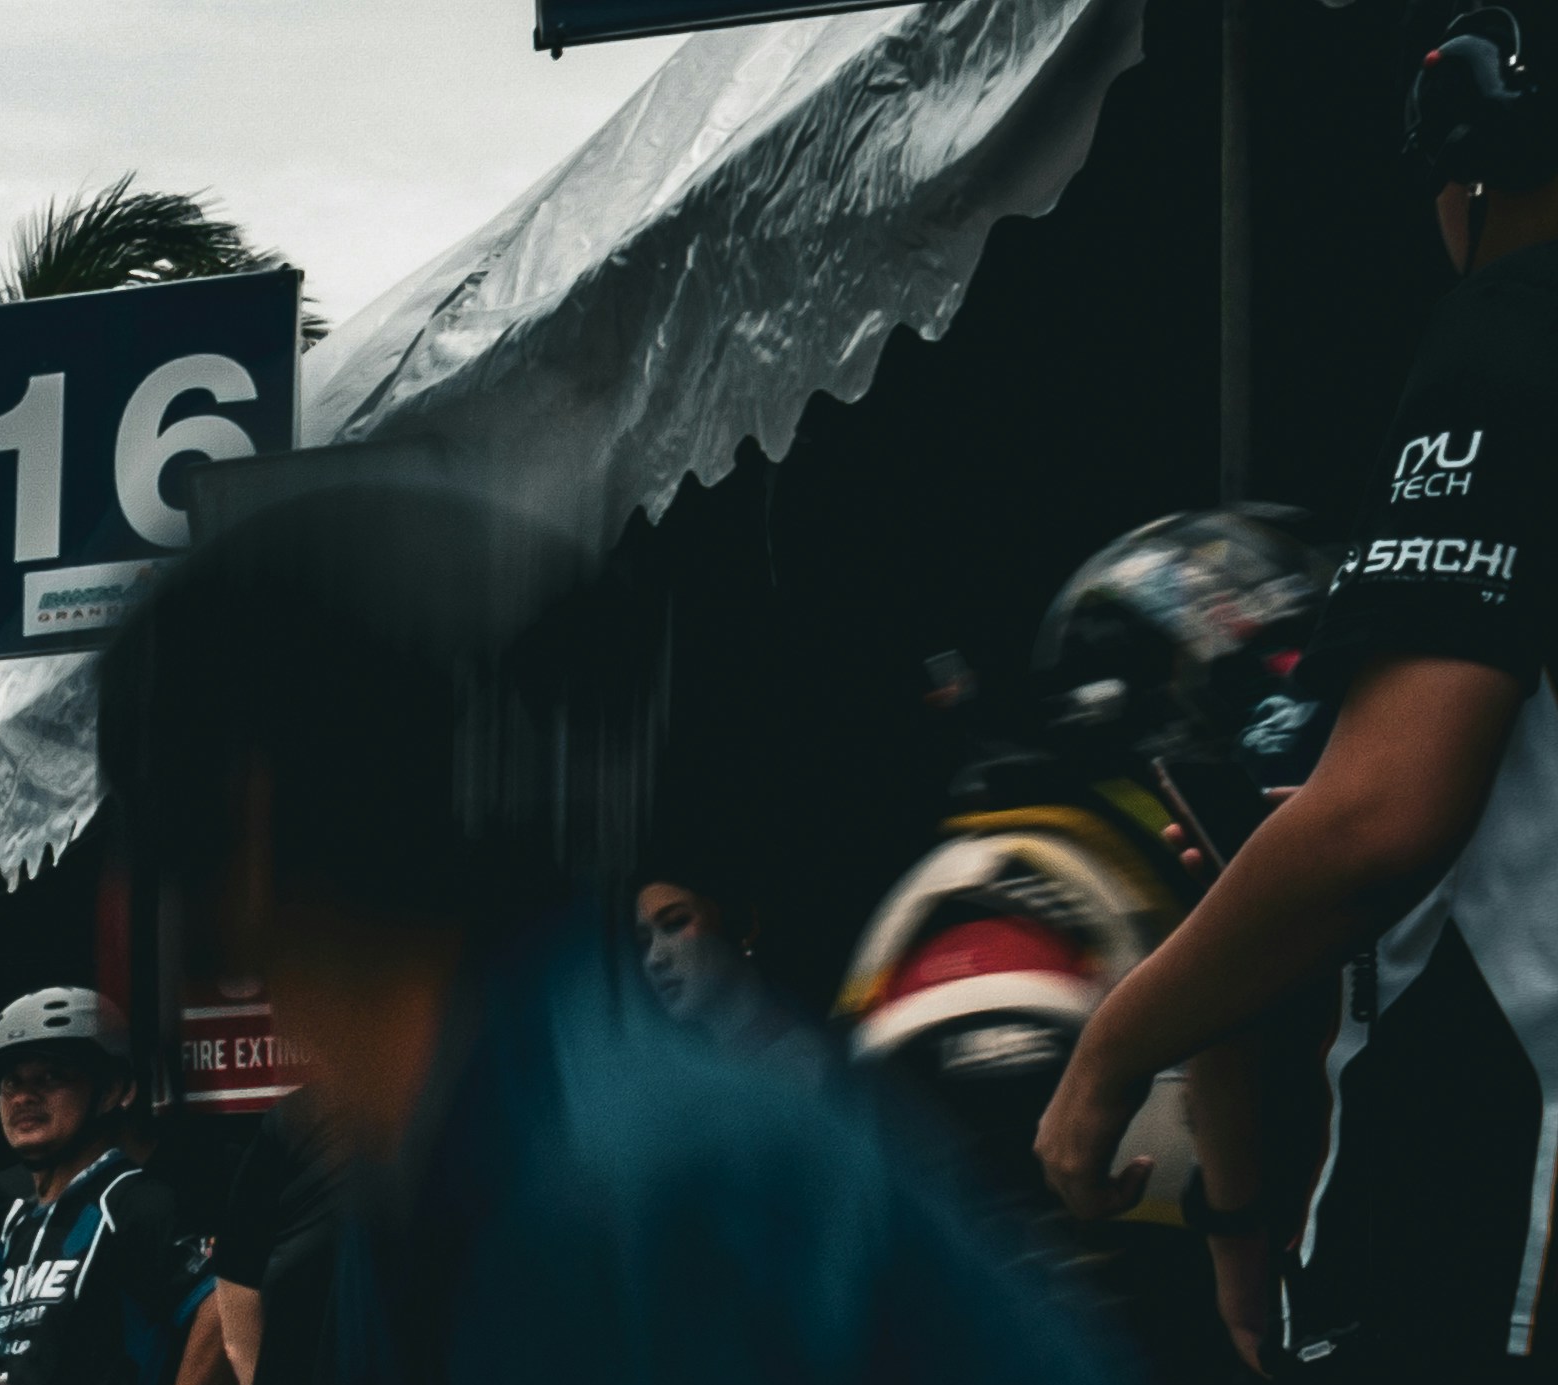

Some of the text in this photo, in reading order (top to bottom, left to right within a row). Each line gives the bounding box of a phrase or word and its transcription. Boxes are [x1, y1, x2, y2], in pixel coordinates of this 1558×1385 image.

[1390, 472, 1472, 503] TECH
[1362, 536, 1517, 580] SACHI
[182, 1038, 228, 1071] FIRE
[0, 1259, 79, 1306] RIME
